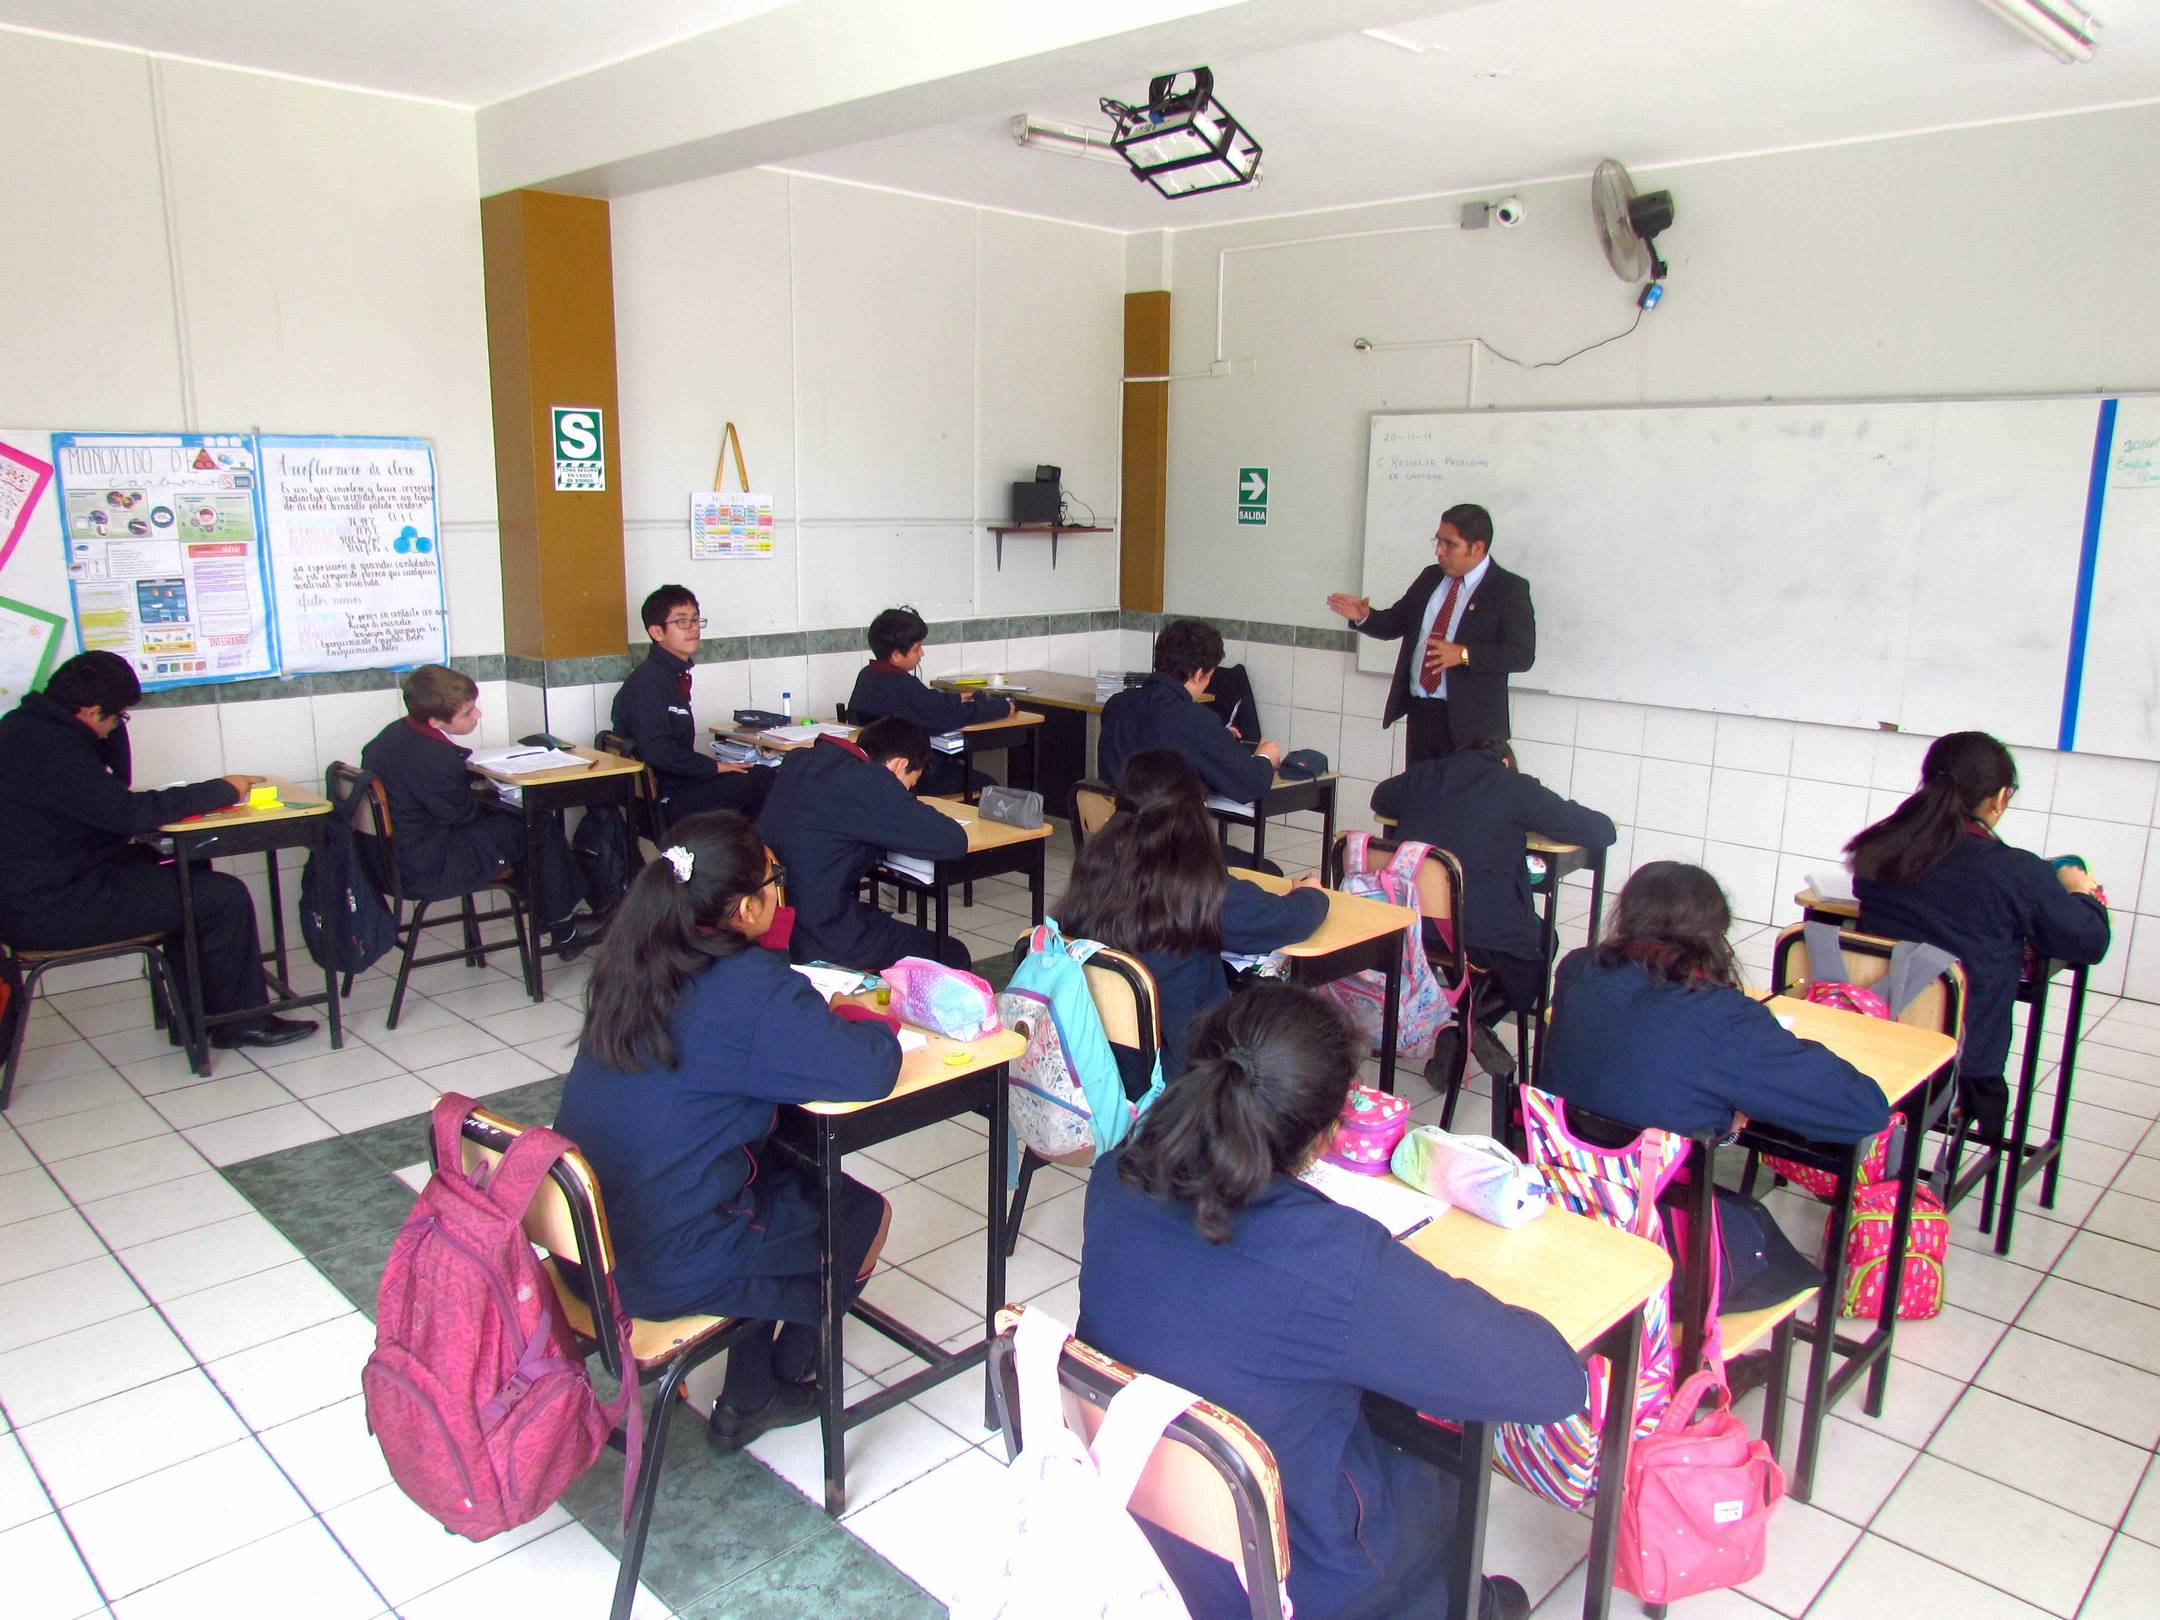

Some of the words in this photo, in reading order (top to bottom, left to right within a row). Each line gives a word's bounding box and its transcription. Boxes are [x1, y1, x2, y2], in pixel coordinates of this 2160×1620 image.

[560, 413, 597, 459] S
[170, 447, 199, 474] DE
[1239, 511, 1266, 521] SALIDA
